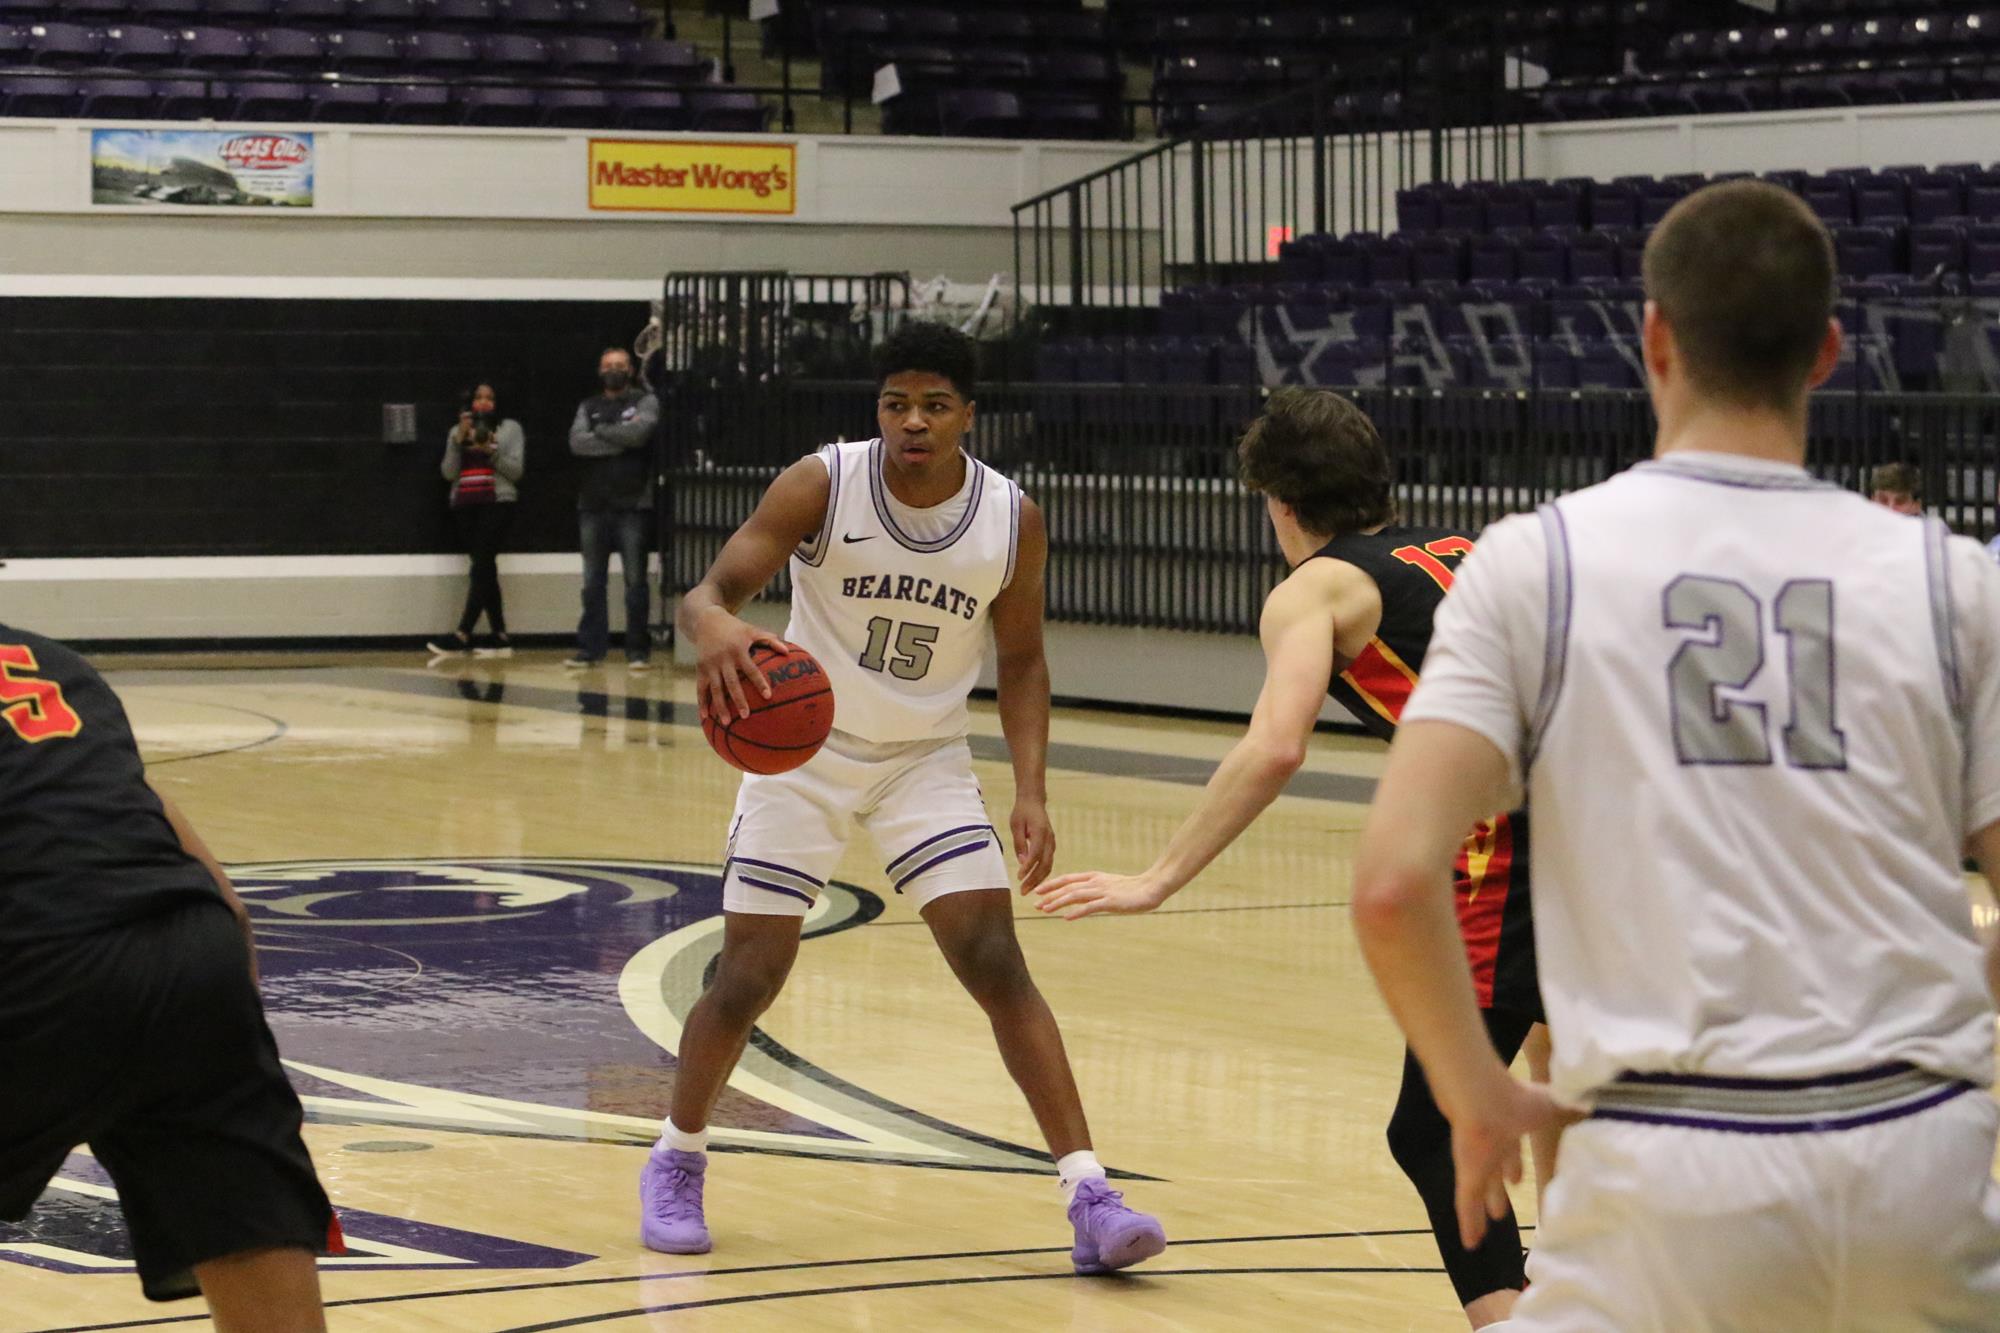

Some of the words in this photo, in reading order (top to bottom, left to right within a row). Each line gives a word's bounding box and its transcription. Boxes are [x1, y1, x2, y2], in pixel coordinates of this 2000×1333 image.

[596, 160, 689, 188] Master
[690, 163, 789, 198] Wong's
[842, 574, 978, 621] BEARCATS
[858, 615, 940, 681] 15
[767, 657, 821, 689] NCAA
[1661, 573, 1849, 772] 21
